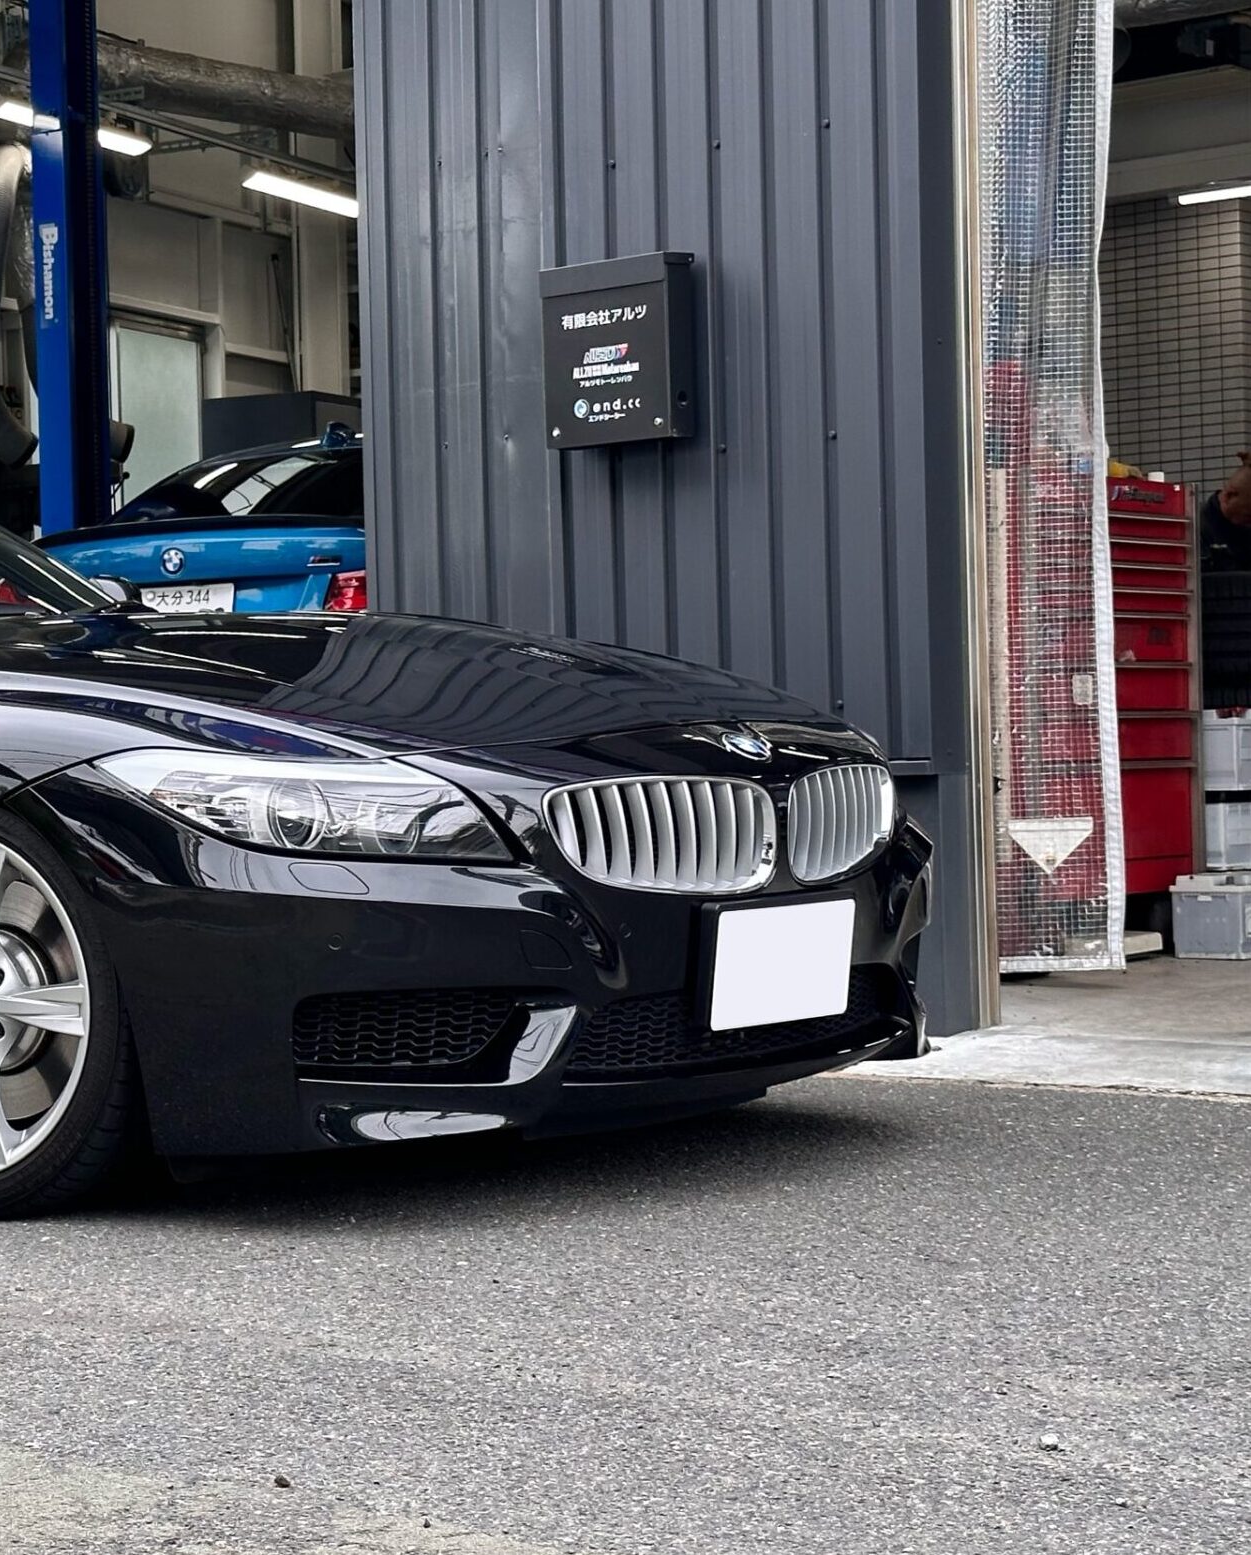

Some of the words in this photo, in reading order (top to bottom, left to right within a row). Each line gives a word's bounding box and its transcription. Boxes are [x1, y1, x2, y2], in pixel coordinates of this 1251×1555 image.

[39, 223, 59, 320] Bishamon
[561, 304, 647, 330] 有限会社アルツ
[156, 591, 183, 606] 大分
[185, 589, 210, 605] 344
